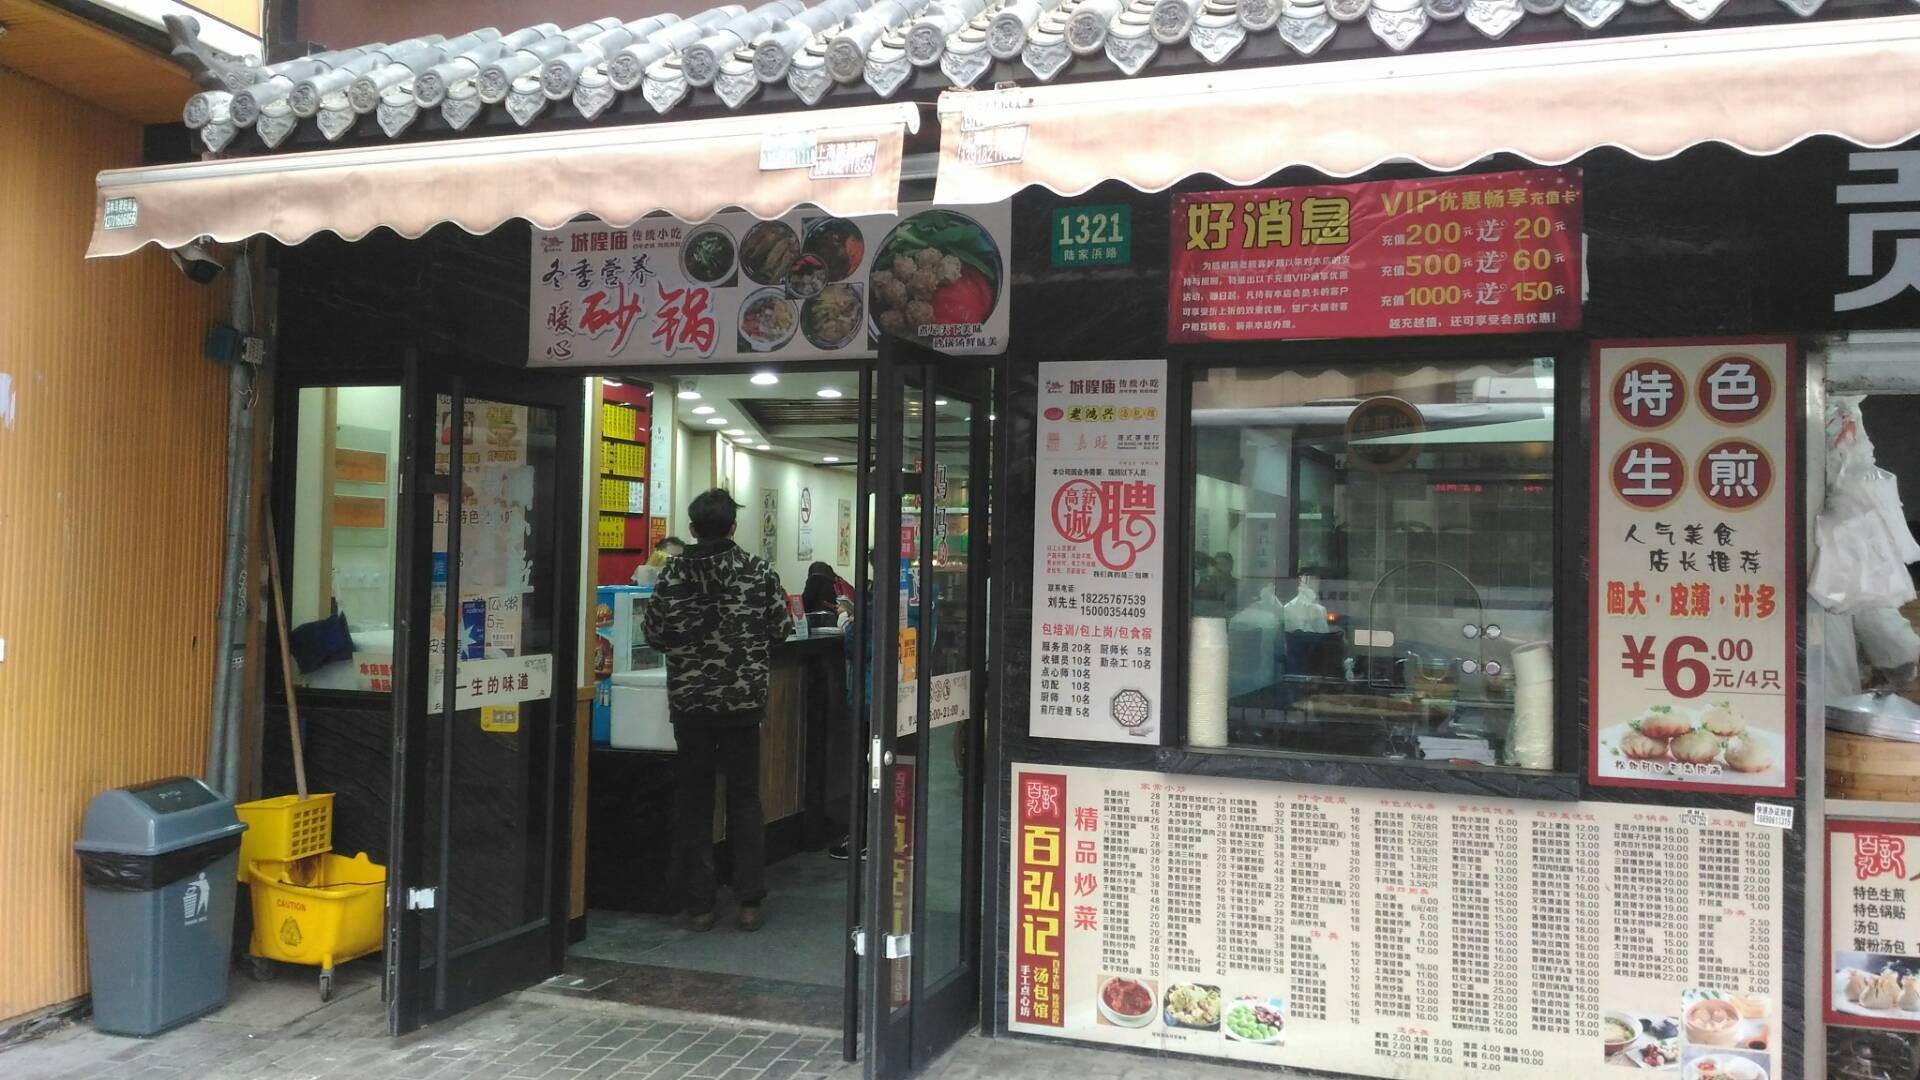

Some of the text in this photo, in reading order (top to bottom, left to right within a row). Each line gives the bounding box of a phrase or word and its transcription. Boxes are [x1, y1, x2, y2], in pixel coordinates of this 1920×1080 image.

[1059, 213, 1123, 245] 1321
[1186, 197, 1350, 250] 好消息
[571, 231, 627, 253] 城隍庙
[632, 227, 682, 241] 传统小吃
[1064, 247, 1117, 261] 陆家浜路
[542, 254, 654, 288] 冬季营养
[579, 280, 716, 353] 砂锅
[546, 300, 573, 357] 暖心
[1070, 380, 1115, 394] 城隍庙
[1623, 362, 1759, 417] 特色
[1622, 448, 1758, 497] 生煎
[1624, 522, 1737, 546] 人气美食
[1649, 549, 1762, 574] 店长推荐
[1047, 583, 1075, 593] 联系电话
[1048, 593, 1146, 609] 刘先生 18225767539
[1080, 606, 1146, 618] 15000354409
[487, 615, 505, 630] 5元
[1041, 642, 1069, 653] 服务员
[1071, 643, 1091, 654] 20名
[1137, 646, 1152, 657] 5名
[1072, 656, 1091, 667] 10名
[1132, 659, 1152, 670] 10名
[1072, 669, 1091, 679] 10名
[456, 673, 529, 697] 一生的味道
[1072, 682, 1091, 692] 10名
[1072, 694, 1090, 705] 10名
[1664, 827, 1688, 835] 18.00
[1664, 835, 1688, 843] 19.00
[1662, 844, 1688, 852] 20.00
[1664, 853, 1688, 861] 19.00
[1074, 806, 1098, 931] 精品炒菜
[1664, 861, 1688, 869] 18.00
[1664, 870, 1688, 878] 19.00
[1662, 878, 1688, 887] 20.00
[1023, 824, 1060, 957] 百弘记
[1664, 887, 1688, 895] 19.00
[1853, 885, 1906, 902] 特色生煎
[277, 898, 306, 912] CAUTION
[1664, 895, 1688, 904] 18.00
[1664, 904, 1688, 913] 19.00
[1853, 903, 1906, 920] 特色锅贴
[1662, 913, 1688, 921] 28.00
[1662, 921, 1688, 930] 28.00
[1853, 920, 1880, 936] 汤包
[1664, 931, 1688, 939] 18.00
[1664, 939, 1688, 948] 15.00
[1853, 937, 1906, 954] 蟹粉汤包
[1664, 948, 1688, 956] 16.00
[1662, 956, 1688, 965] 20.00
[1662, 964, 1688, 973] 25.00
[1662, 973, 1688, 982] 22.00
[1020, 965, 1030, 1017] 手工点心坊
[1033, 966, 1049, 1018] 汤包馆
[1481, 1063, 1500, 1071] 2.00
